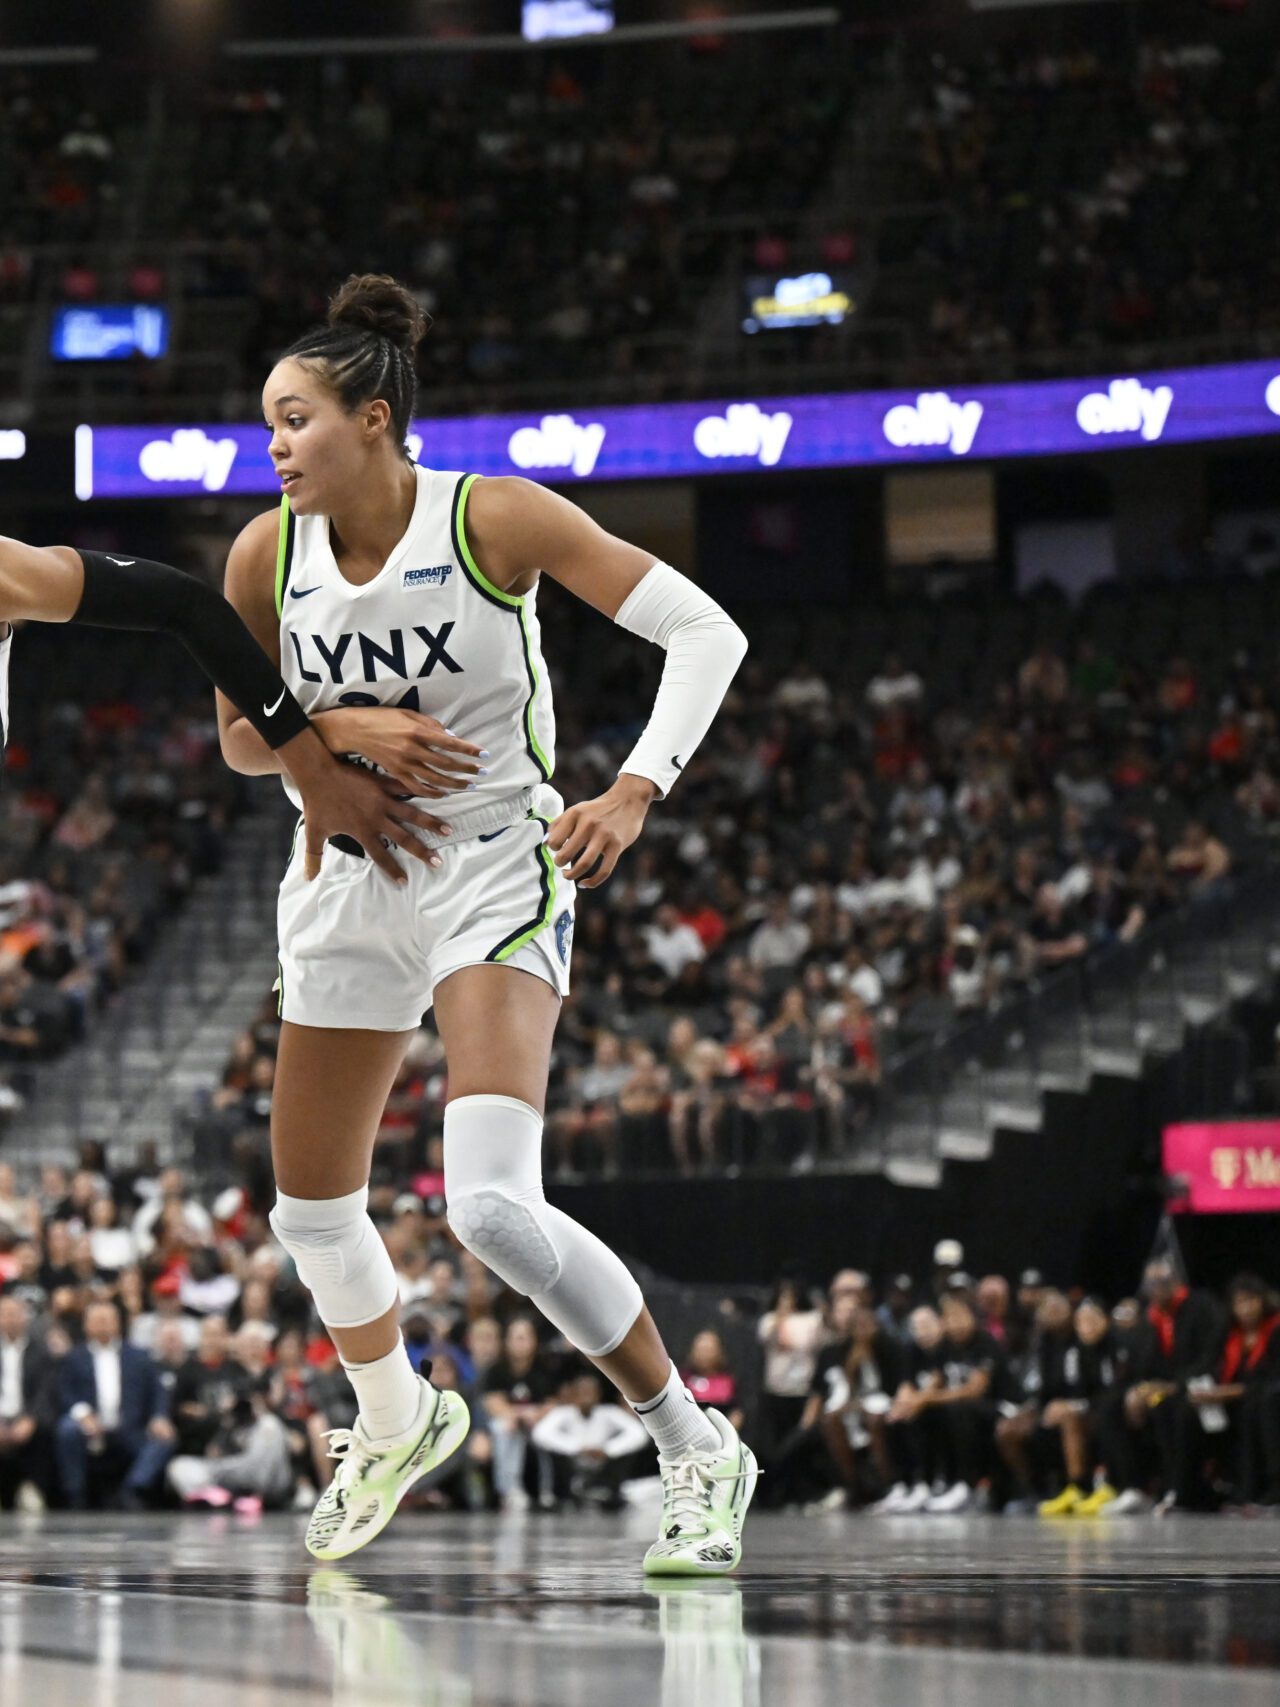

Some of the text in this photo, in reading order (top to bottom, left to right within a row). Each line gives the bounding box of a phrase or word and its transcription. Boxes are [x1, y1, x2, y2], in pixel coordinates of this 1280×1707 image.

[694, 403, 793, 466] ally
[883, 391, 983, 455] ally
[1076, 378, 1173, 441] ally
[139, 428, 238, 491] ally
[508, 414, 605, 477] ally
[404, 565, 452, 580] FEDERATED
[289, 621, 465, 685] LYNX
